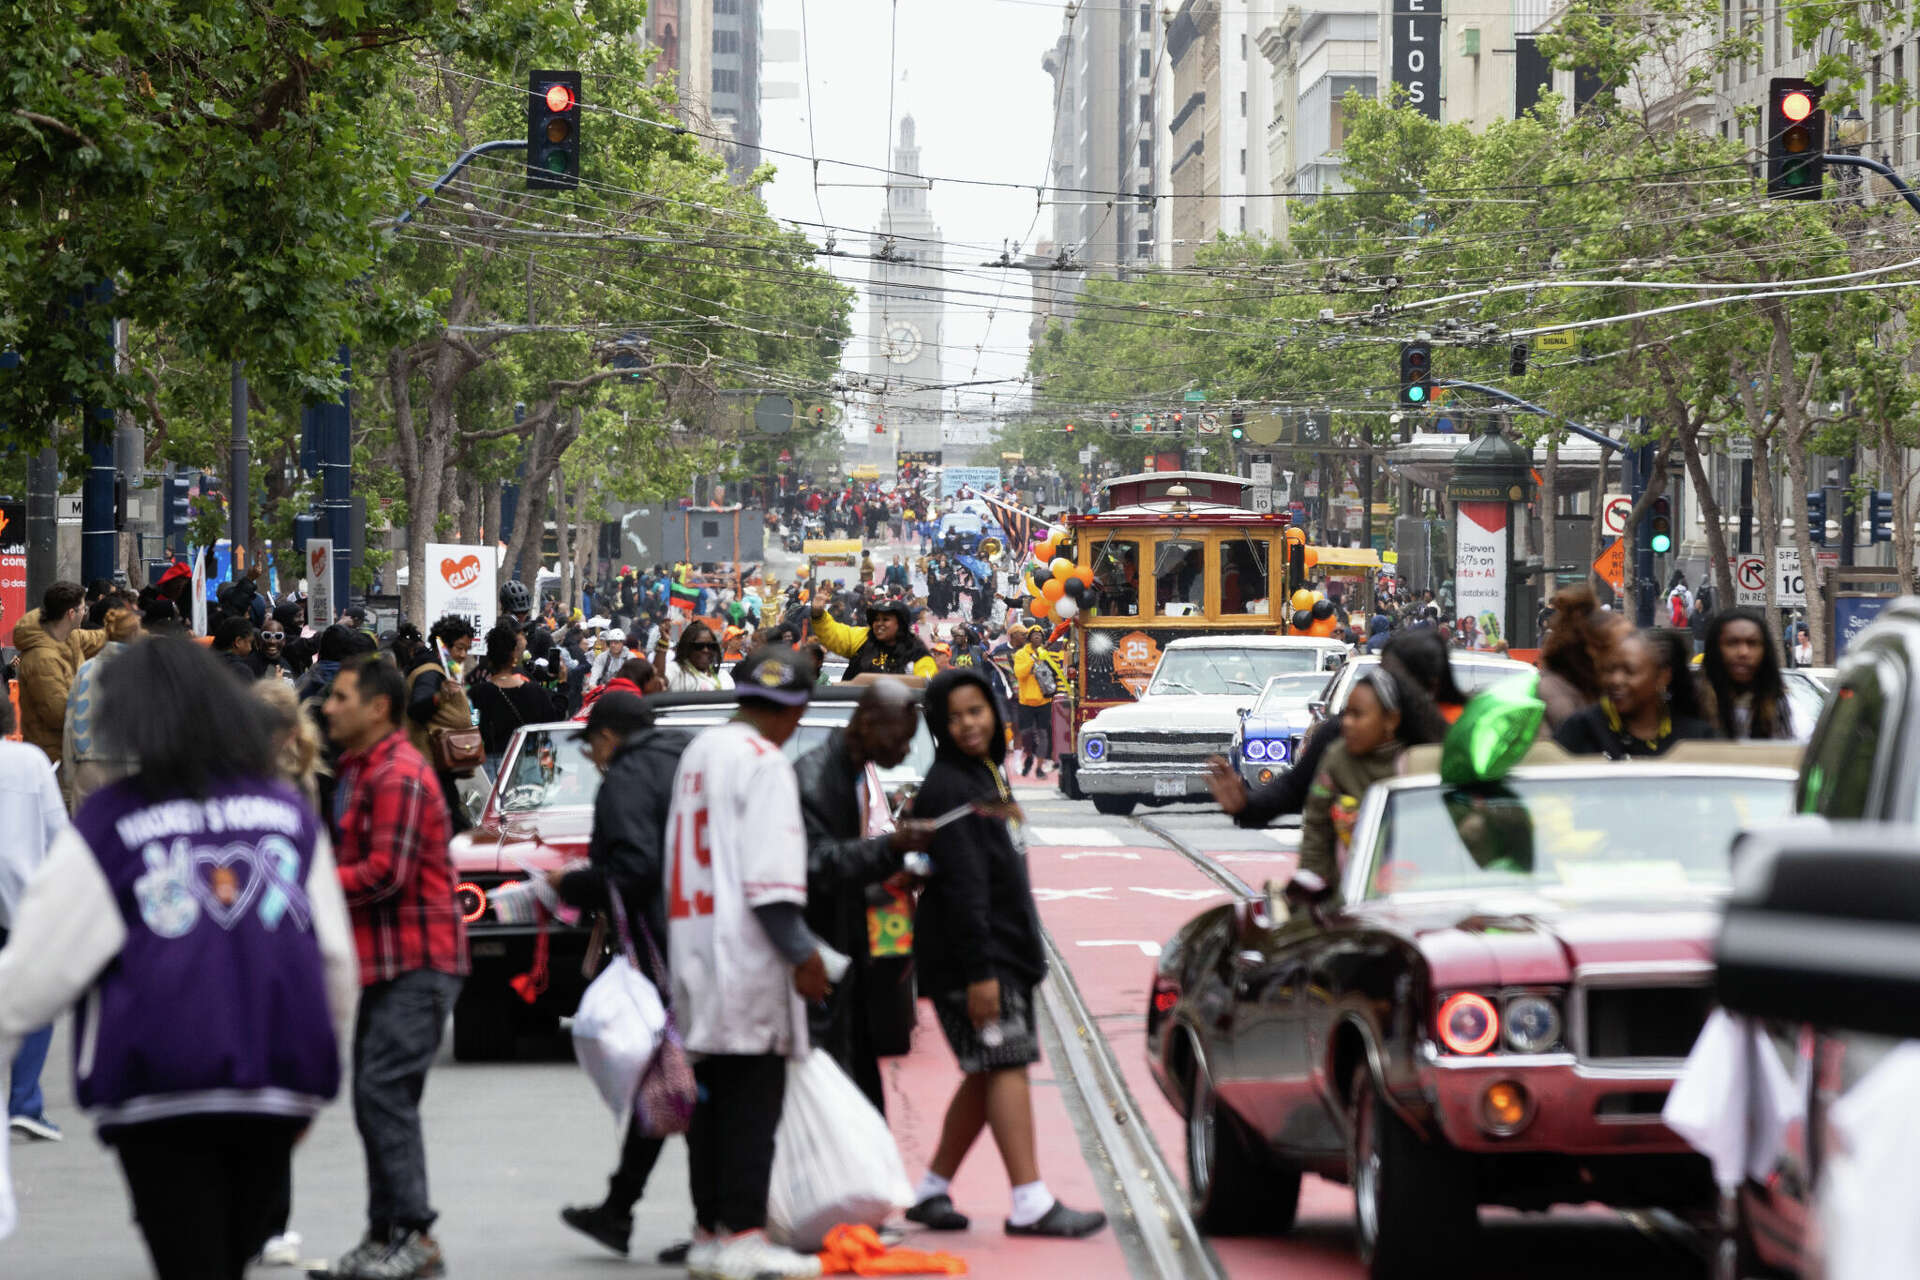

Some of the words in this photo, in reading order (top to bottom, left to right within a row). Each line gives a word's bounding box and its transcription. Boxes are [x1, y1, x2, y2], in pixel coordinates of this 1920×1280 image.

[1256, 500, 1267, 508] 10
[1480, 558, 1494, 566] on
[448, 562, 480, 587] GLIDE
[1740, 592, 1750, 601] ON
[1127, 641, 1148, 659] 25
